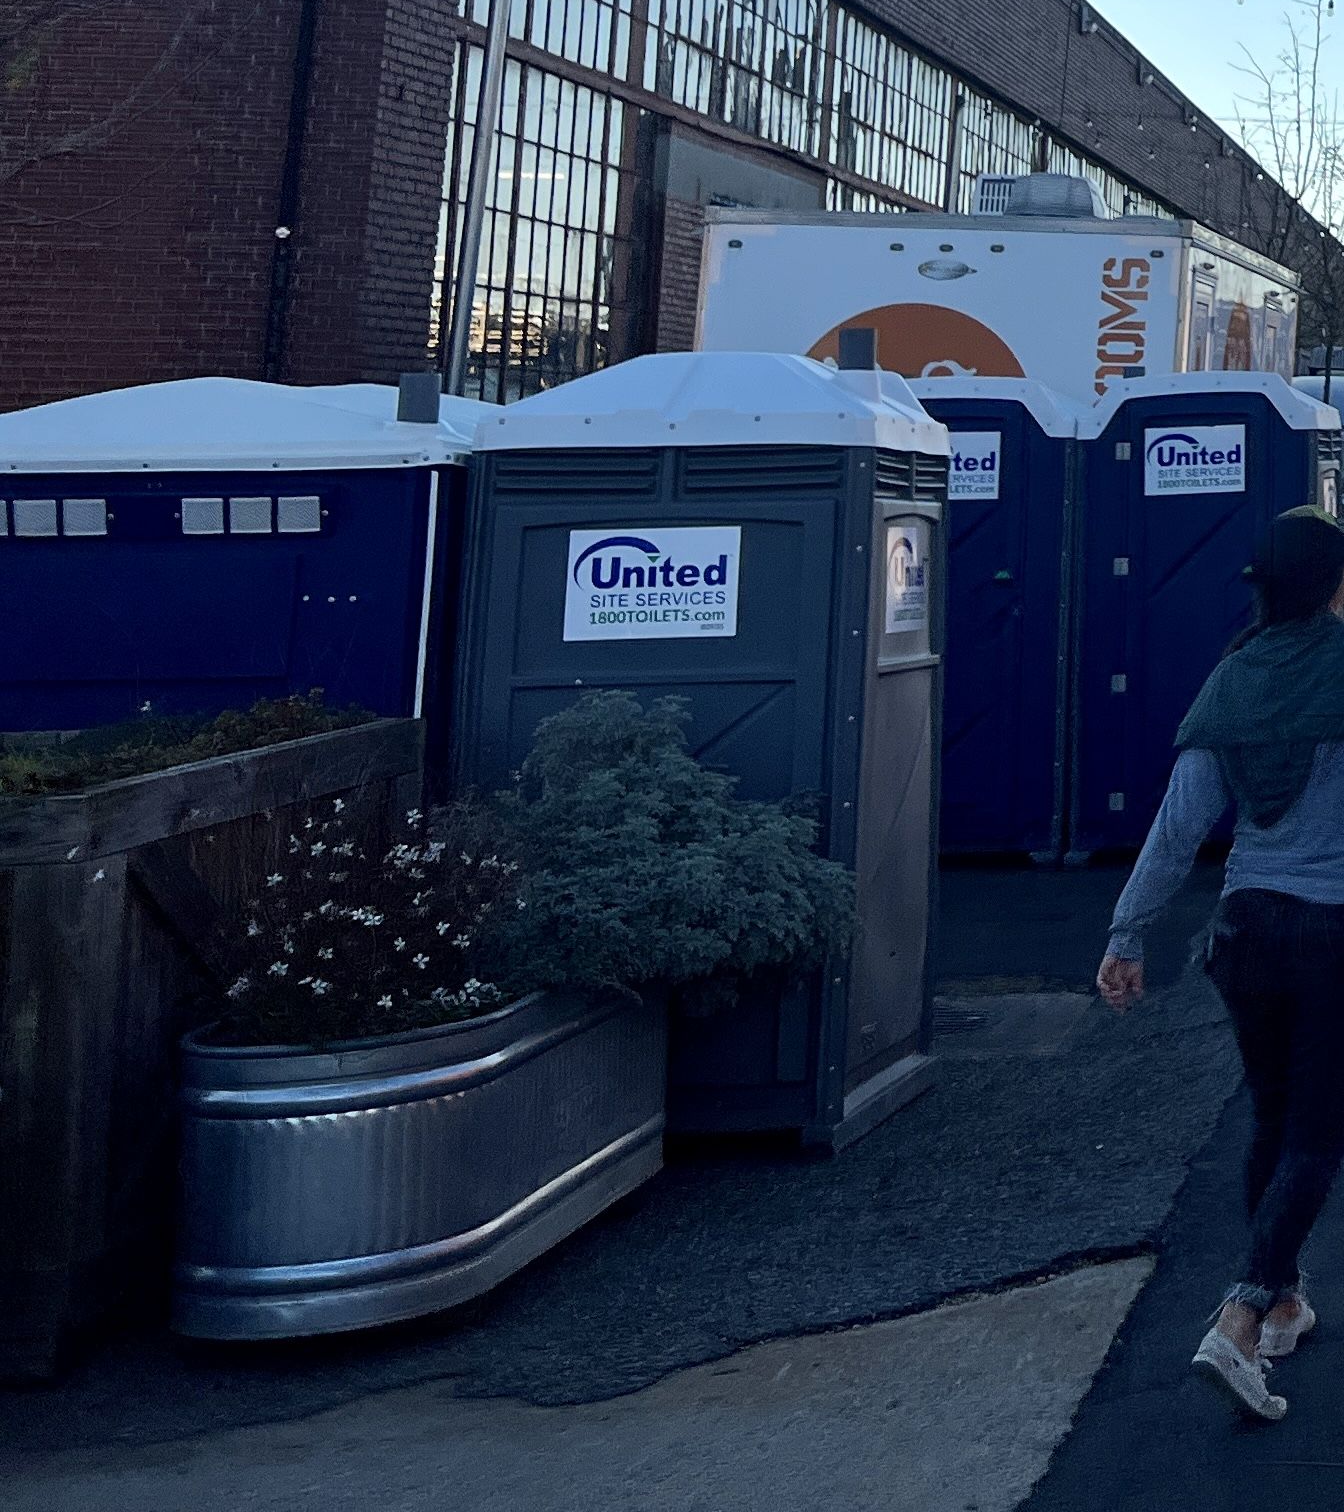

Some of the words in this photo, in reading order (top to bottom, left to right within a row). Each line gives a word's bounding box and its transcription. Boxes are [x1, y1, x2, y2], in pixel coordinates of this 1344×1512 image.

[953, 451, 996, 472] ted
[1156, 443, 1242, 467] United
[953, 474, 995, 483] RVICES
[1158, 469, 1181, 479] SITE
[1185, 467, 1242, 478] SERVICES
[591, 553, 728, 589] United
[590, 593, 629, 608] SITE
[635, 591, 726, 607] SERVICES
[589, 609, 726, 625] 1800TOILETS.com
